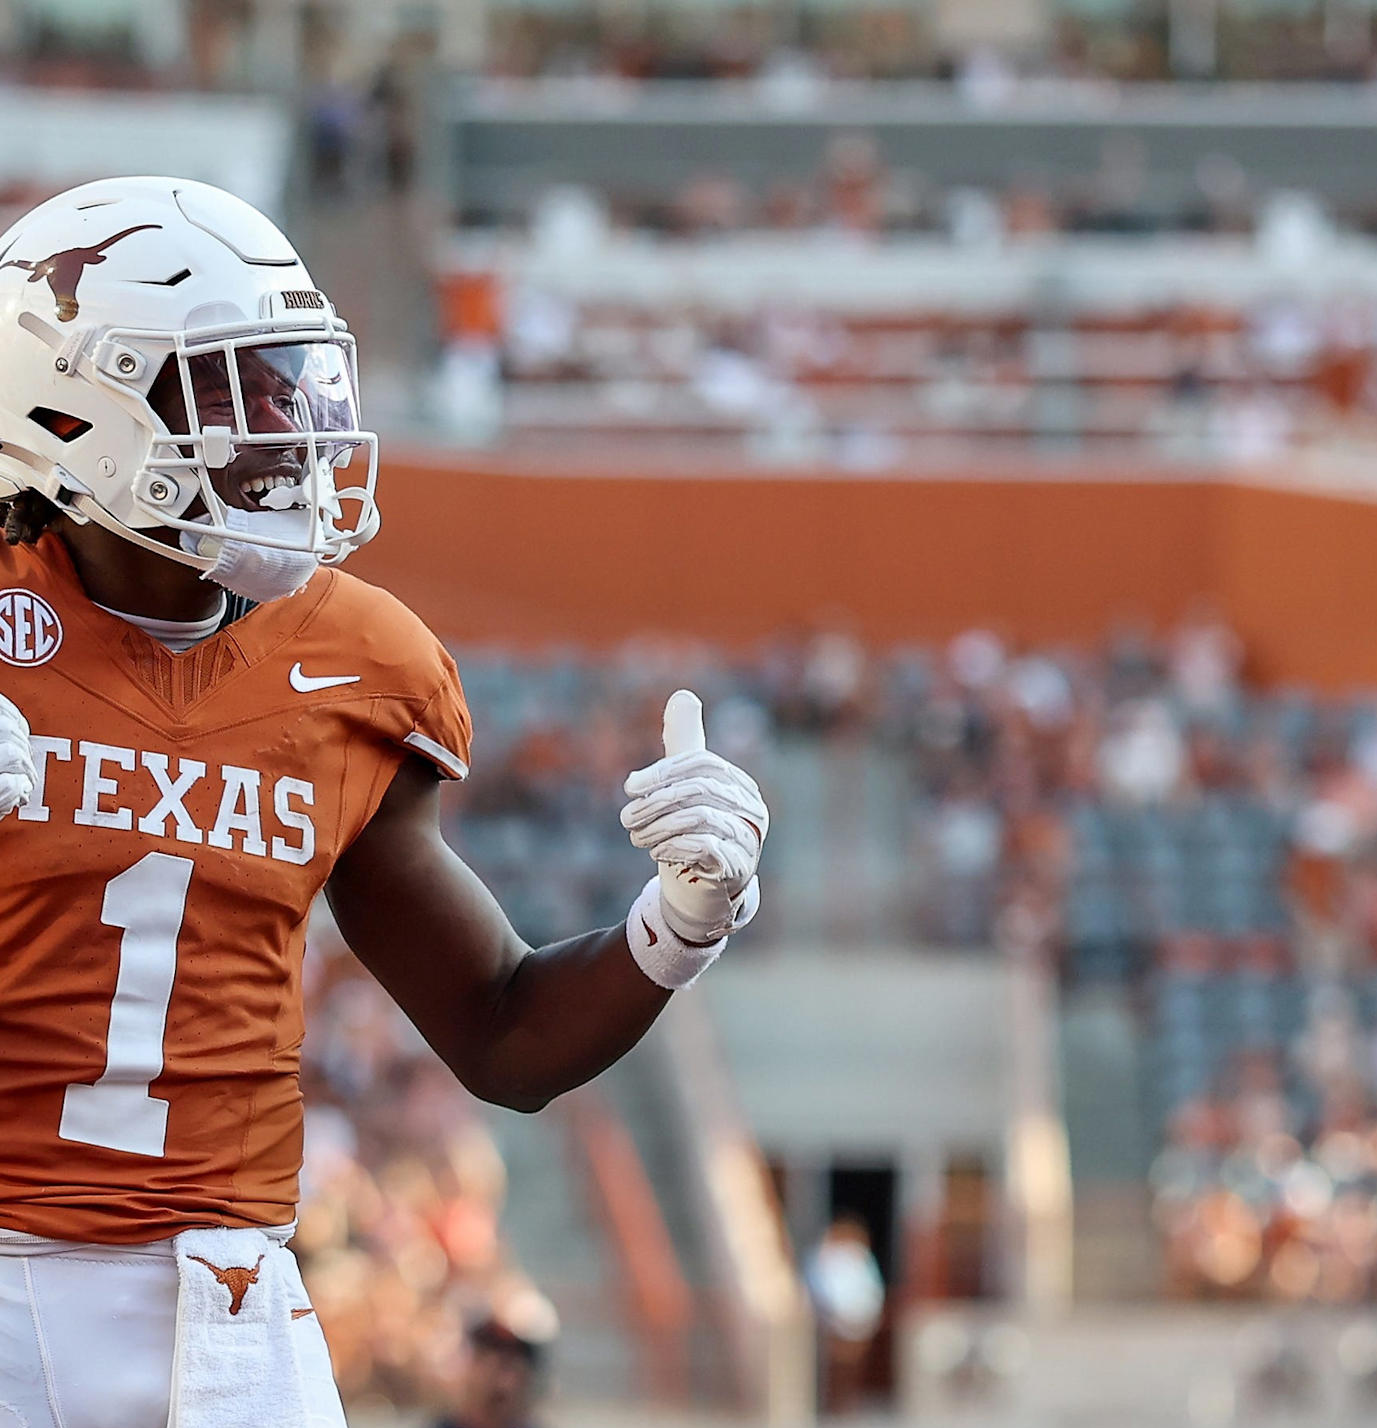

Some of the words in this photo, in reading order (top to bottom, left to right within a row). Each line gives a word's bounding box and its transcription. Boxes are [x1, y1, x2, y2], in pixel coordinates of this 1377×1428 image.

[280, 290, 325, 309] HORNS
[18, 734, 316, 866] TEXAS
[58, 851, 195, 1158] 1
